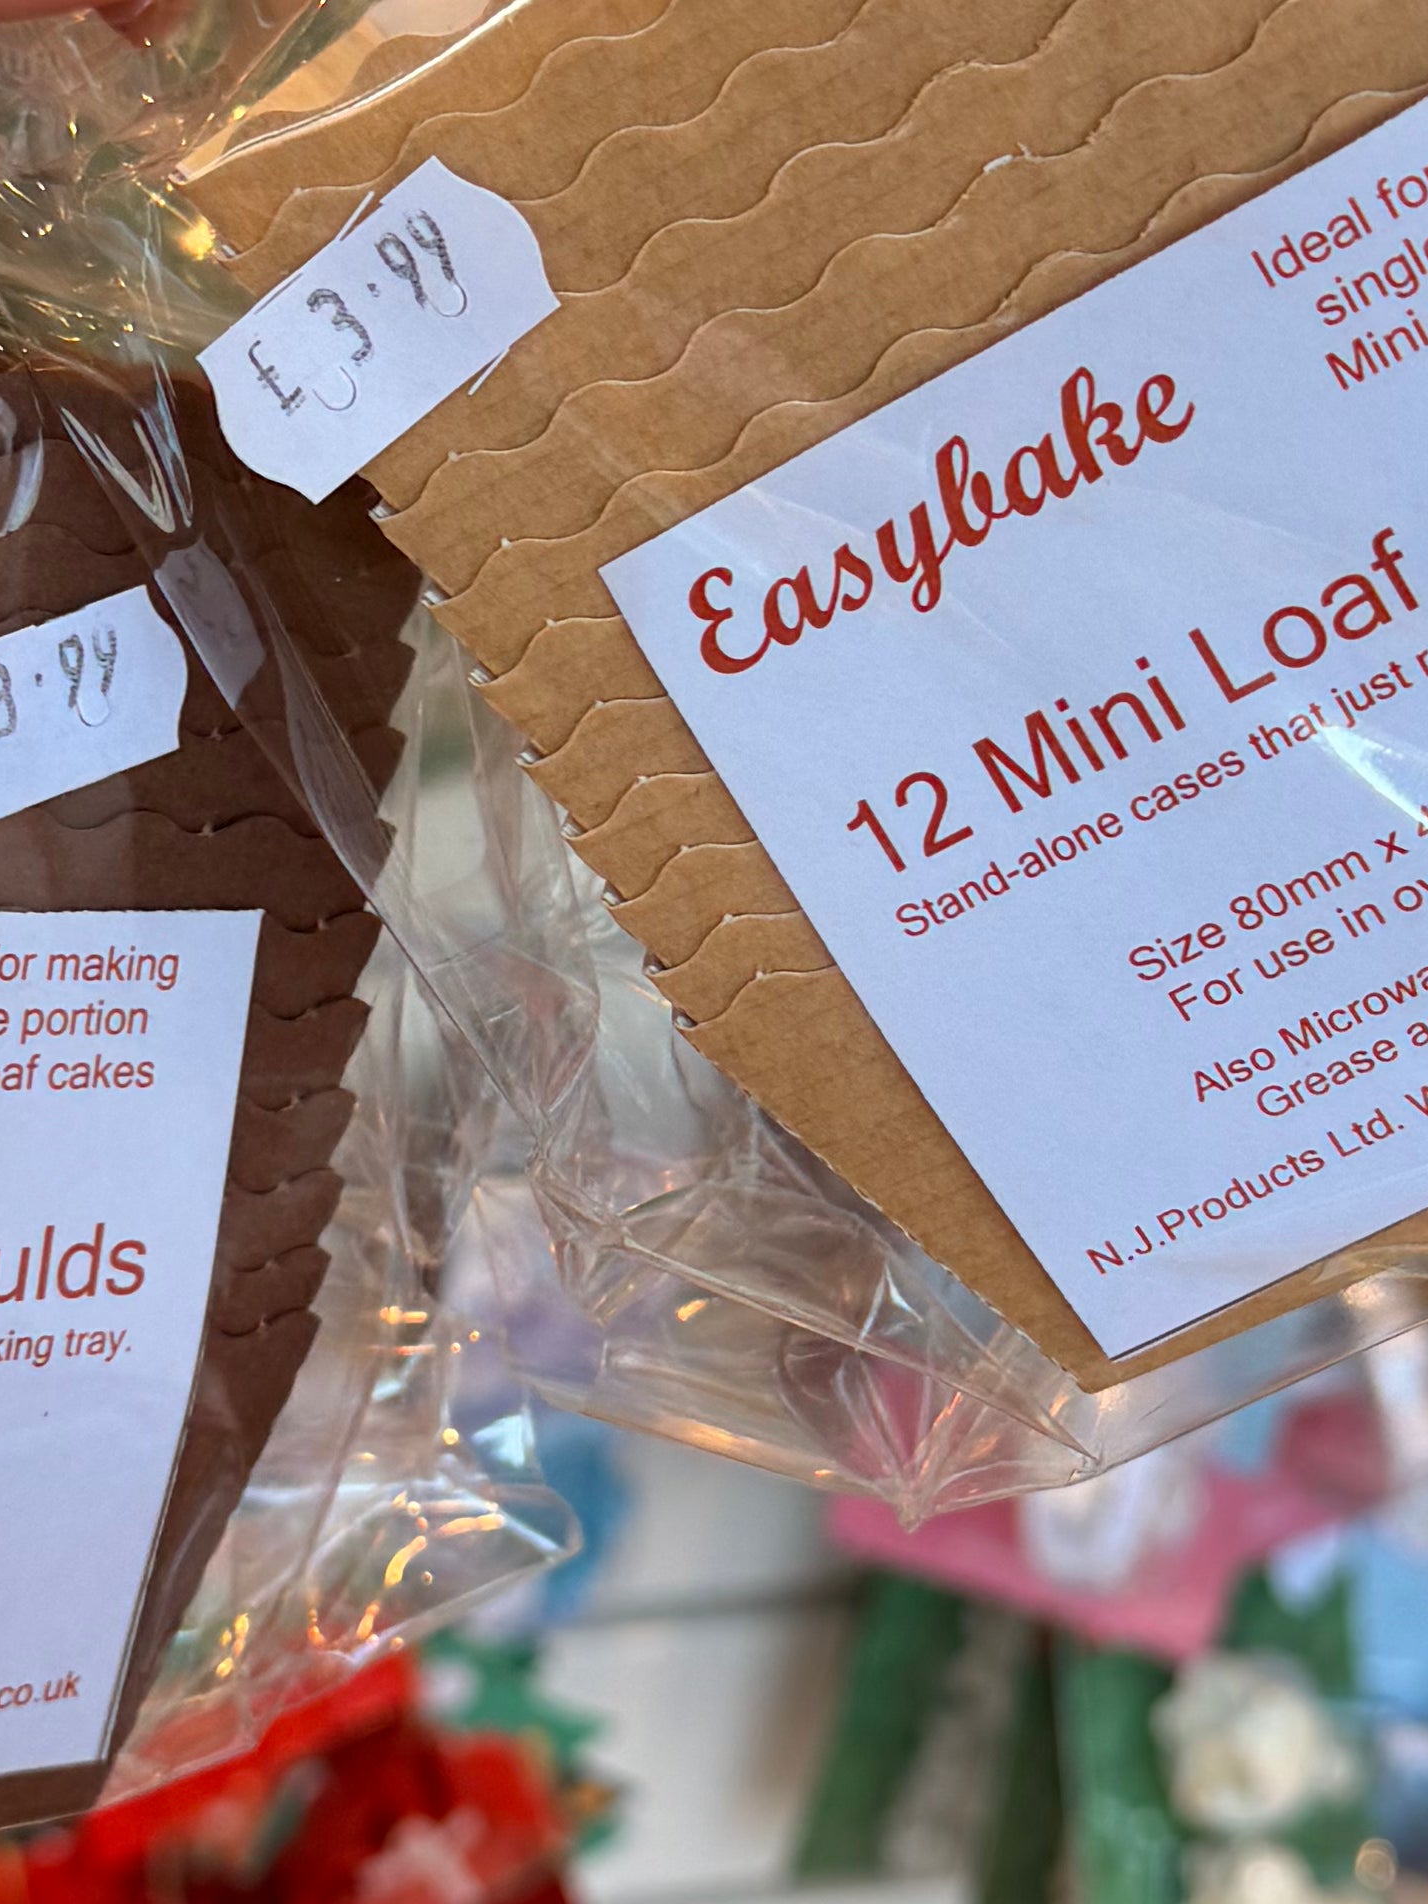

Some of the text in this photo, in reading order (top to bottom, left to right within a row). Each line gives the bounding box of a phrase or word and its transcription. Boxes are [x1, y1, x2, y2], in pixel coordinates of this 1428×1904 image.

[1250, 197, 1372, 288] Ideal
[688, 367, 1195, 675] Easybake
[846, 772, 973, 873] 12
[973, 657, 1185, 814] Mini
[1189, 528, 1419, 703] Loaf
[895, 813, 1122, 937] Stand-alone
[1130, 751, 1245, 822] cases
[1248, 704, 1327, 760] that
[1332, 662, 1412, 728] just
[1129, 924, 1226, 981] Size
[1229, 852, 1371, 930] 80mm
[1375, 832, 1407, 864] x
[46, 948, 179, 991] making
[1168, 969, 1243, 1022] For
[1254, 929, 1334, 979] use
[1341, 904, 1385, 938] in
[20, 1005, 148, 1044] portion
[47, 1056, 153, 1091] cakes
[1194, 1049, 1275, 1103] Also
[1257, 1040, 1398, 1117] Grease
[1327, 1107, 1406, 1159] Ltd.
[65, 1330, 132, 1364] tray.
